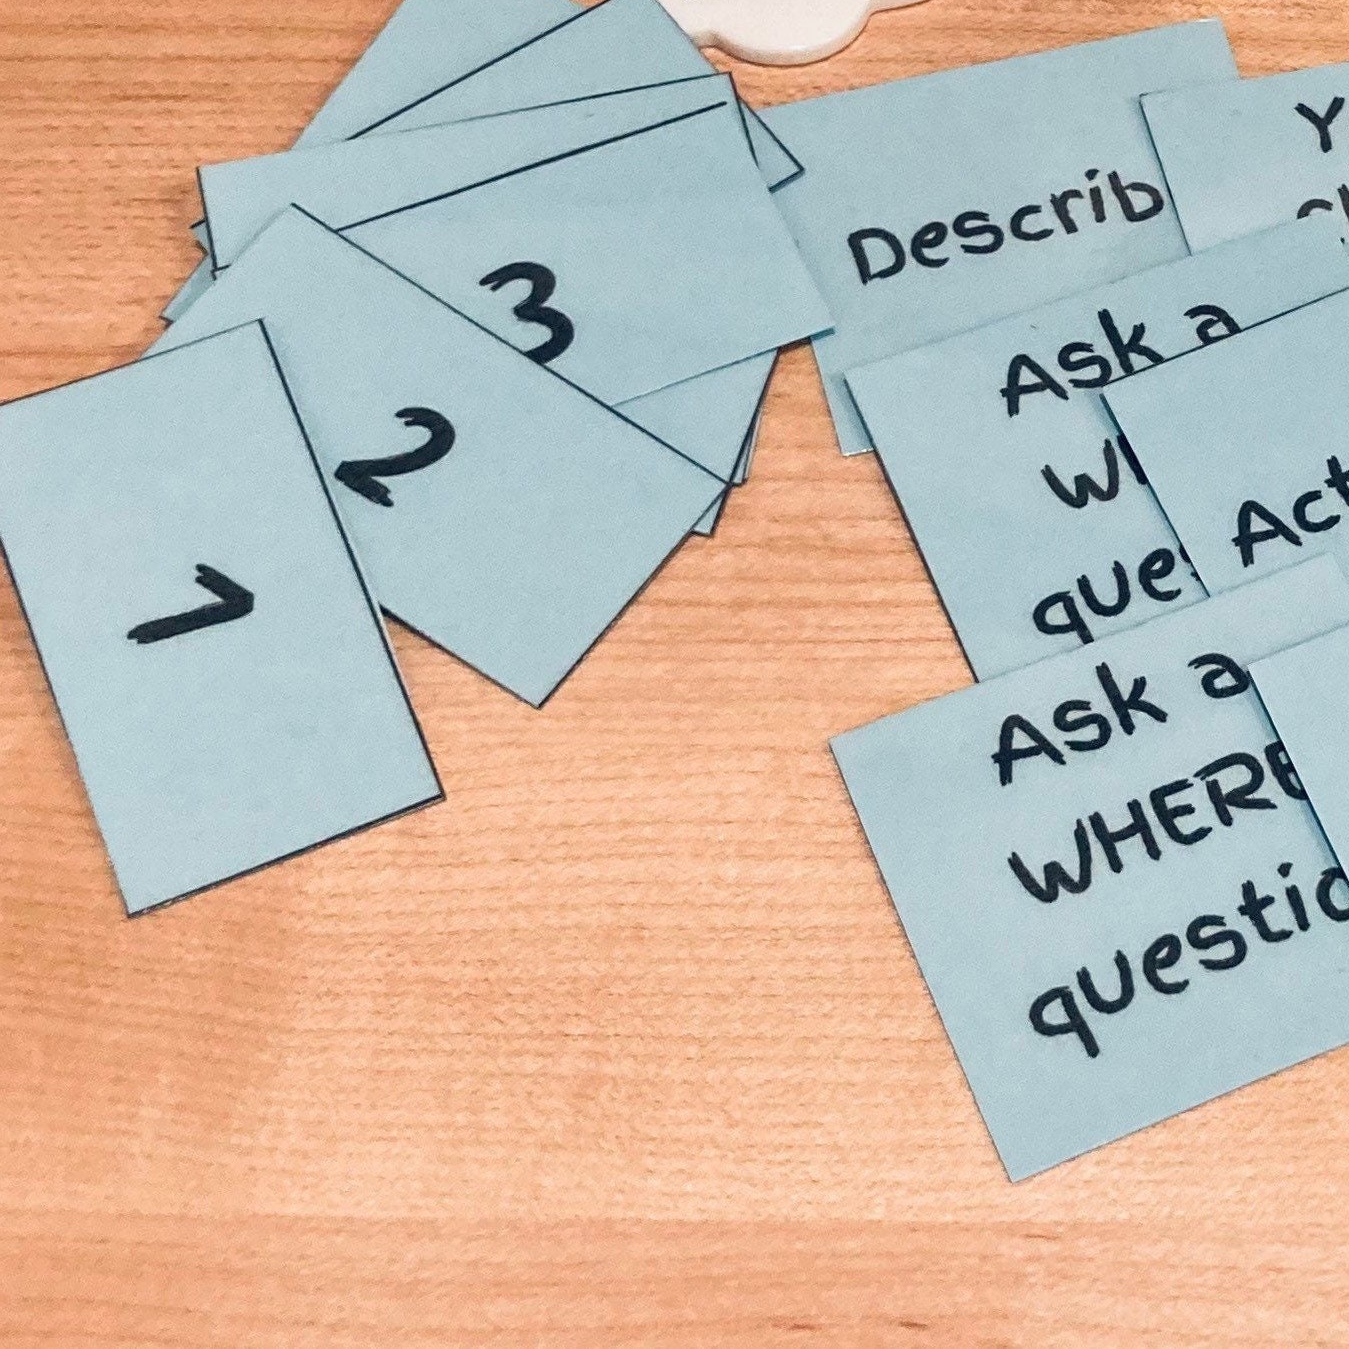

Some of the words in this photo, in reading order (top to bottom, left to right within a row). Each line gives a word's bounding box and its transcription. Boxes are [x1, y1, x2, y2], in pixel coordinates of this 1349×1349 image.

[846, 168, 1165, 285] Describ
[479, 262, 575, 365] 3
[999, 308, 1166, 419] Ask
[1183, 304, 1243, 347] a
[334, 406, 457, 508] 2
[126, 564, 256, 646] 1
[1032, 542, 1202, 645] que
[991, 661, 1168, 787] Ask
[1187, 652, 1251, 699] a
